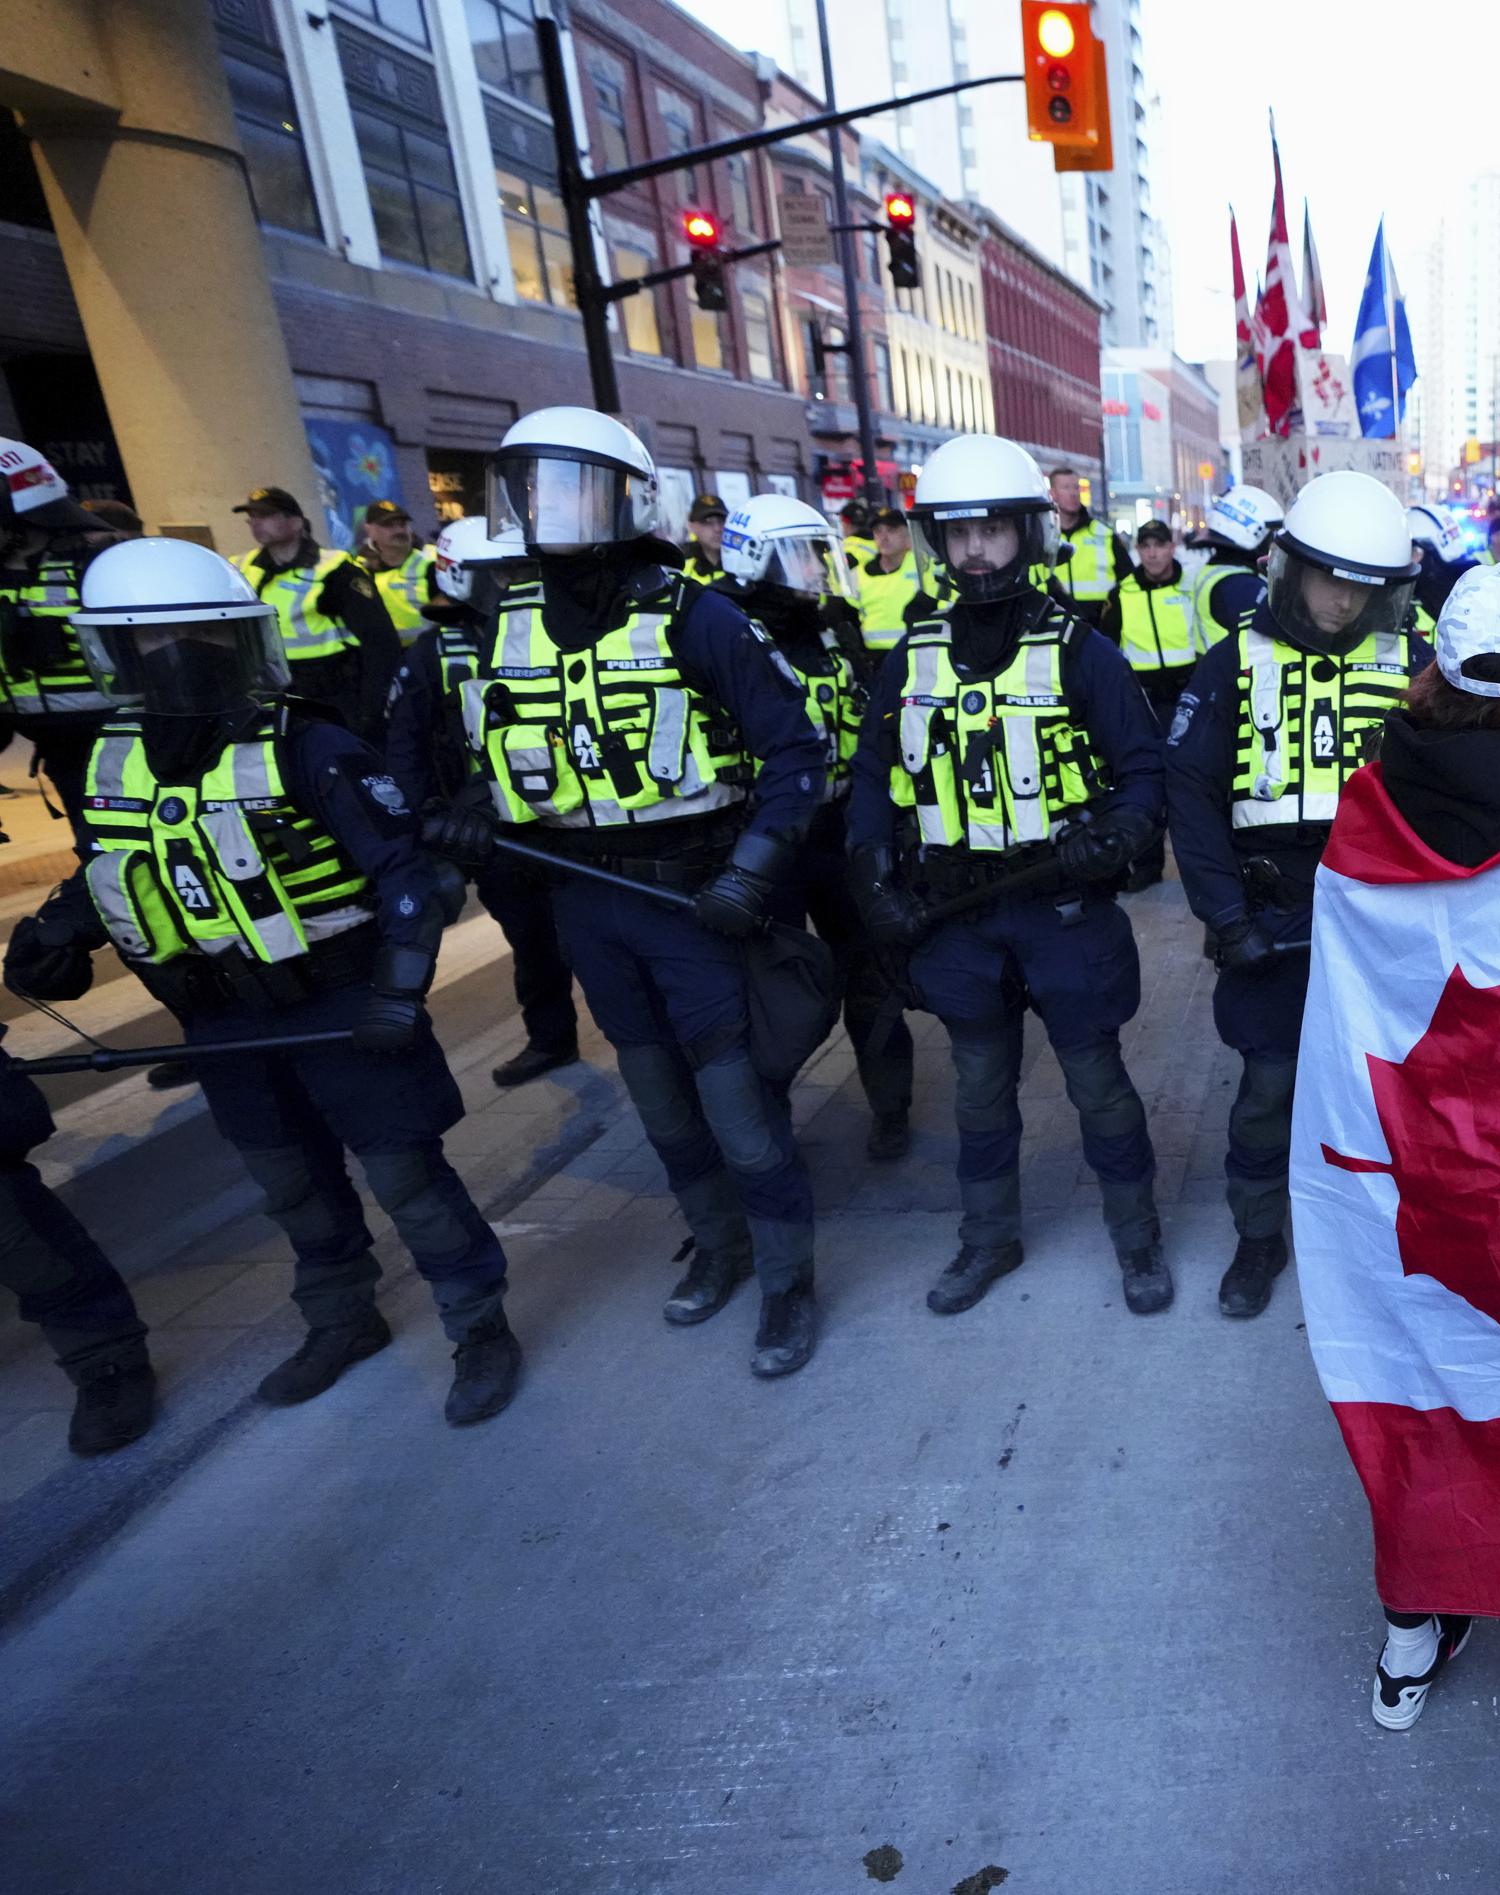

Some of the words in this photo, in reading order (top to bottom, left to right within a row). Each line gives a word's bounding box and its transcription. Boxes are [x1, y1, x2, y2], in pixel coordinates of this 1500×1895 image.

[1346, 572, 1373, 584] POLICE
[607, 658, 666, 671] POLICE
[1352, 663, 1405, 675] POLICE
[1005, 694, 1060, 707] POLICE
[574, 723, 593, 747] A
[1313, 715, 1334, 737] A
[1313, 736, 1335, 757] 12
[575, 747, 601, 769] 21
[205, 798, 280, 812] POLICE
[174, 864, 203, 888] A
[179, 886, 211, 908] 21
